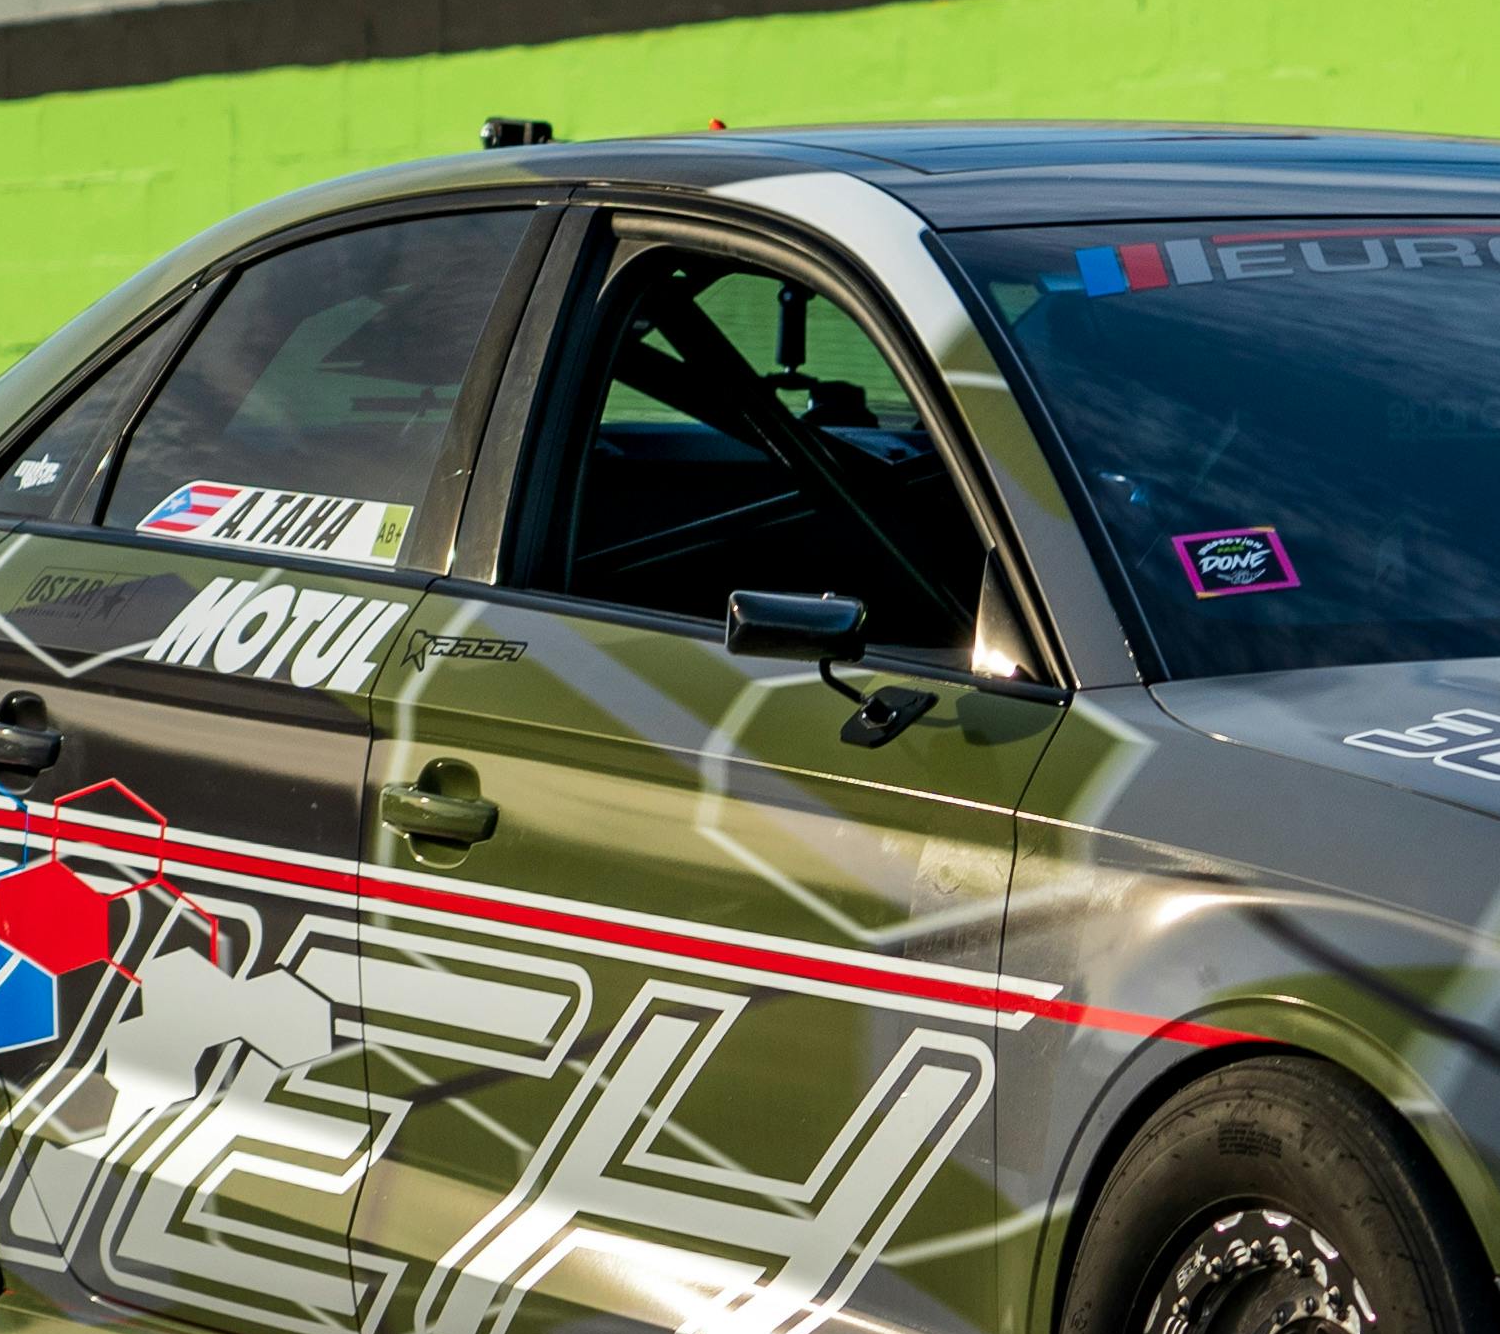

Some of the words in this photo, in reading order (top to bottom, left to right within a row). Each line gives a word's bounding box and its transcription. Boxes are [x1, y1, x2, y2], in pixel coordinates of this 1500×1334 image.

[376, 522, 402, 545] AB+
[1199, 549, 1272, 575] DONE
[144, 577, 409, 693] MOTUL
